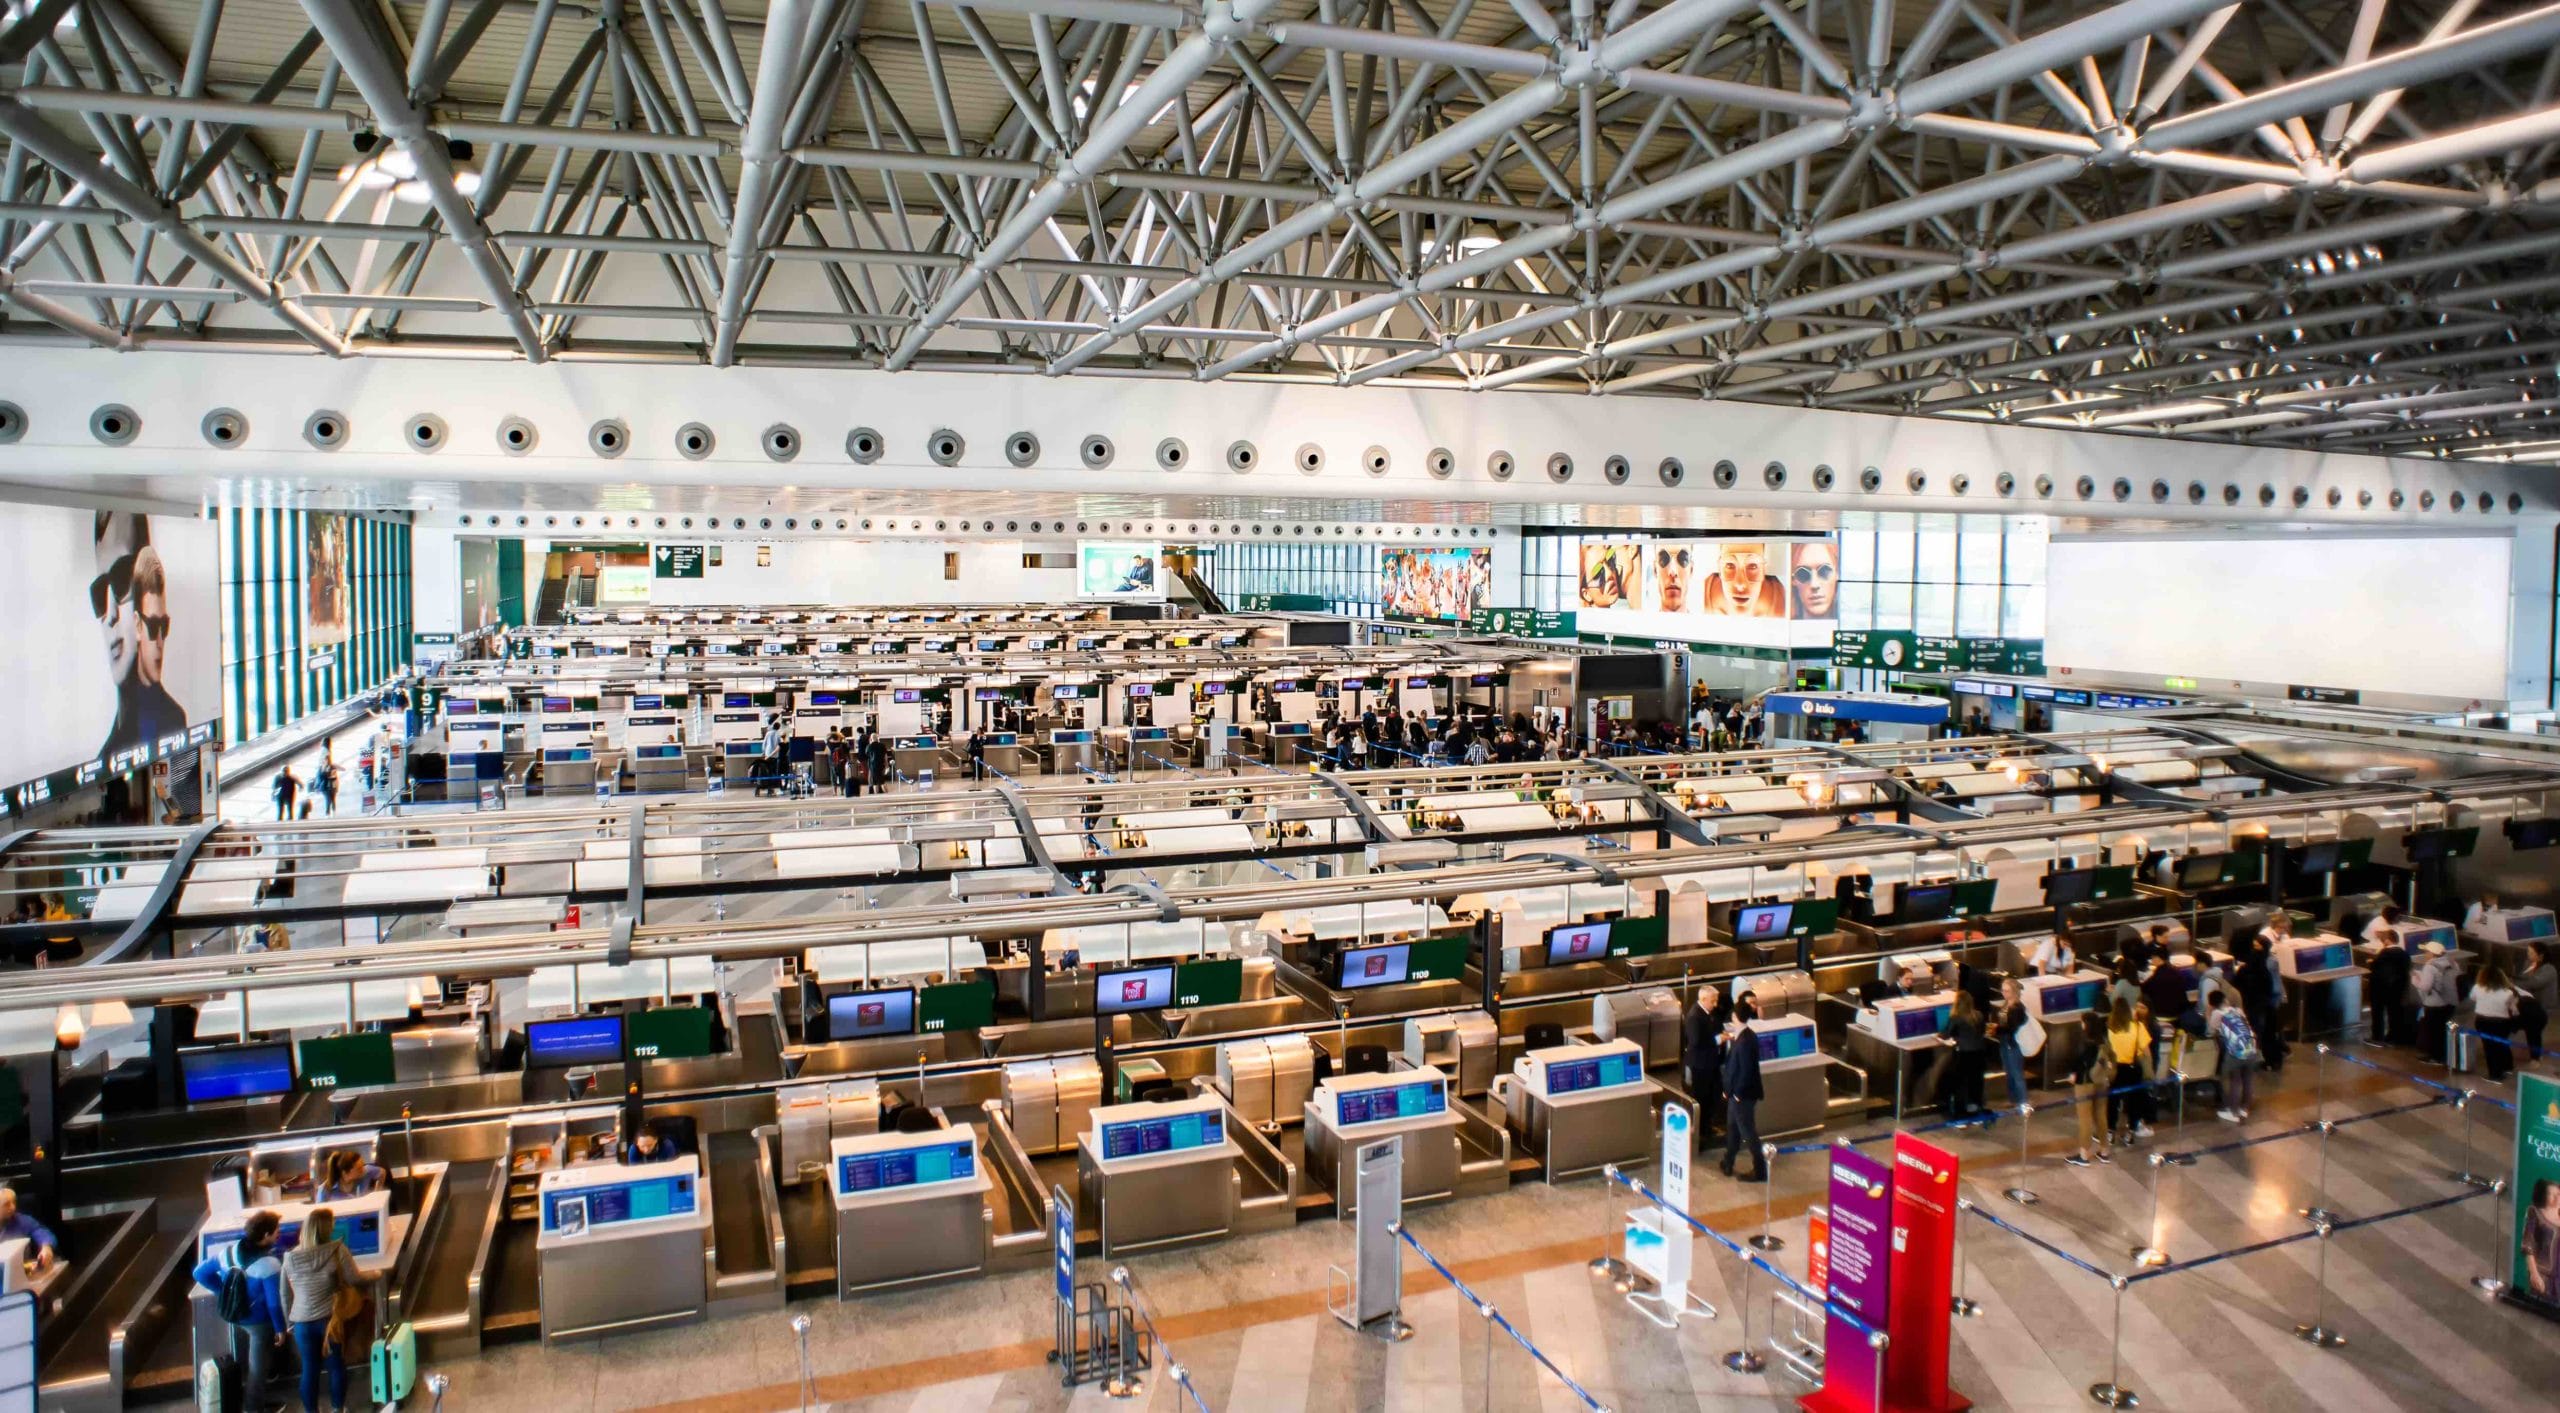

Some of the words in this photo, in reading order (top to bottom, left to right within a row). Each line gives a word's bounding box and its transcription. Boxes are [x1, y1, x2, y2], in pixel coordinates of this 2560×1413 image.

[1675, 655, 1684, 668] 9
[422, 692, 432, 706] 9
[797, 708, 821, 716] Check-in
[1815, 703, 1836, 714] Info
[715, 713, 739, 721] Check-in
[76, 866, 118, 888] 10
[1180, 995, 1199, 1005] 1110
[925, 1019, 945, 1030] 1111
[634, 1045, 658, 1056] 1112
[309, 1075, 337, 1087] 1113
[1897, 1151, 1934, 1175] IBERIA
[1833, 1163, 1870, 1189] IBERIA
